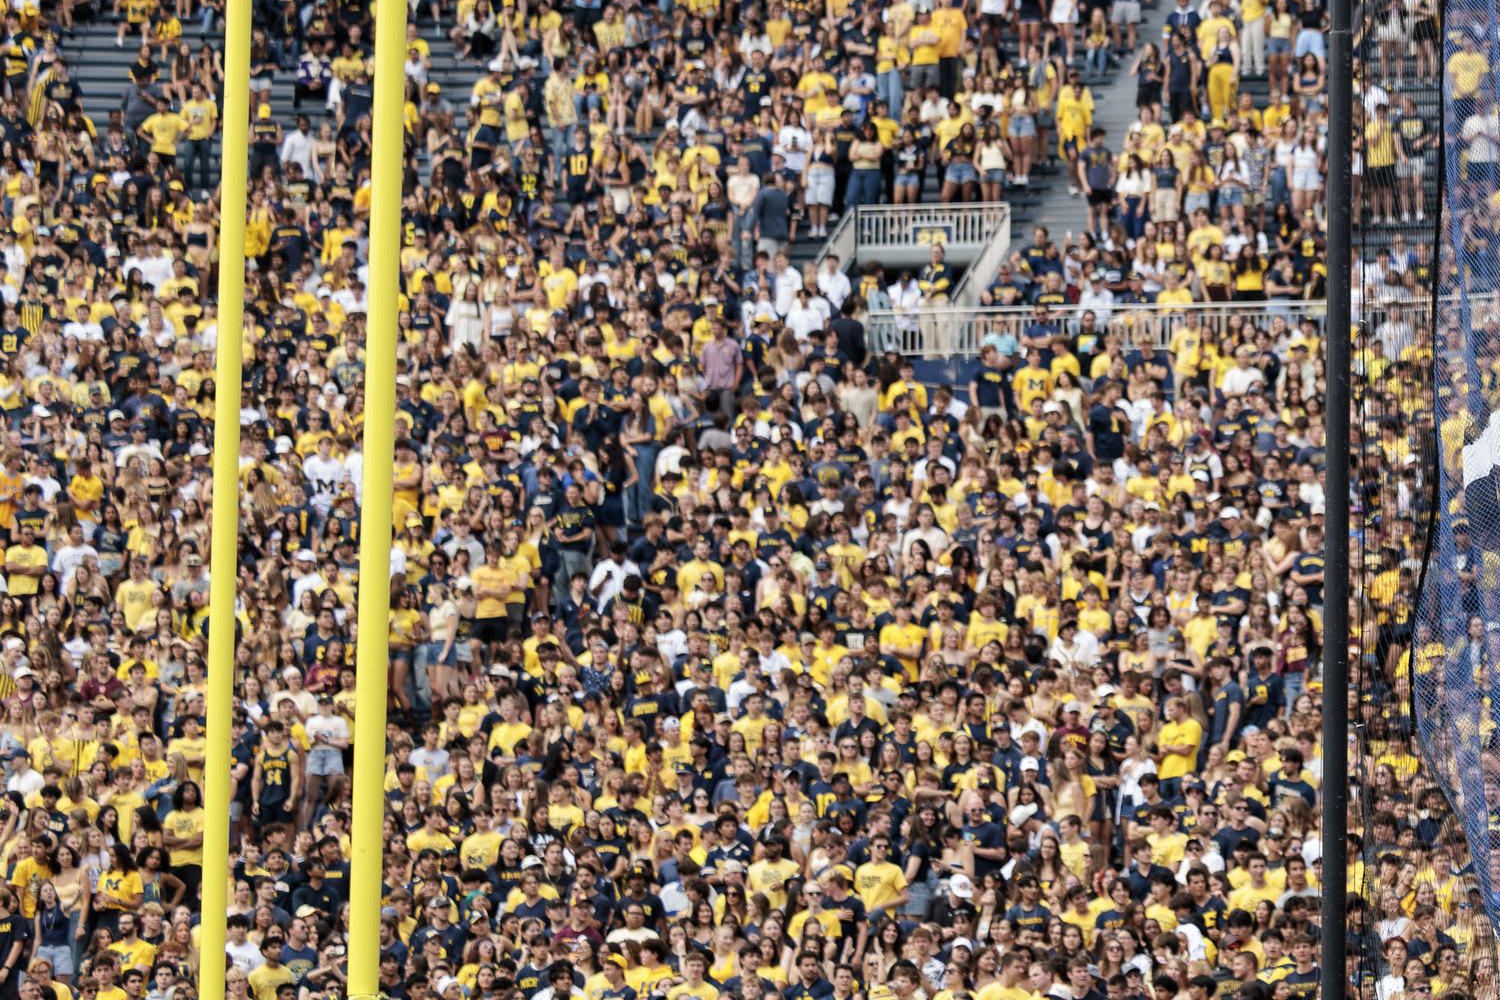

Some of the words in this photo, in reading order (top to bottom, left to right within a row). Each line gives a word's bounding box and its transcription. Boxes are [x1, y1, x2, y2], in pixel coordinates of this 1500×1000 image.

[570, 154, 588, 176] 10
[405, 227, 415, 246] 5
[916, 231, 947, 246] 28
[2, 334, 18, 352] 21
[1029, 378, 1045, 391] M
[317, 480, 336, 494] M
[1190, 540, 1207, 553] M
[106, 878, 124, 891] M
